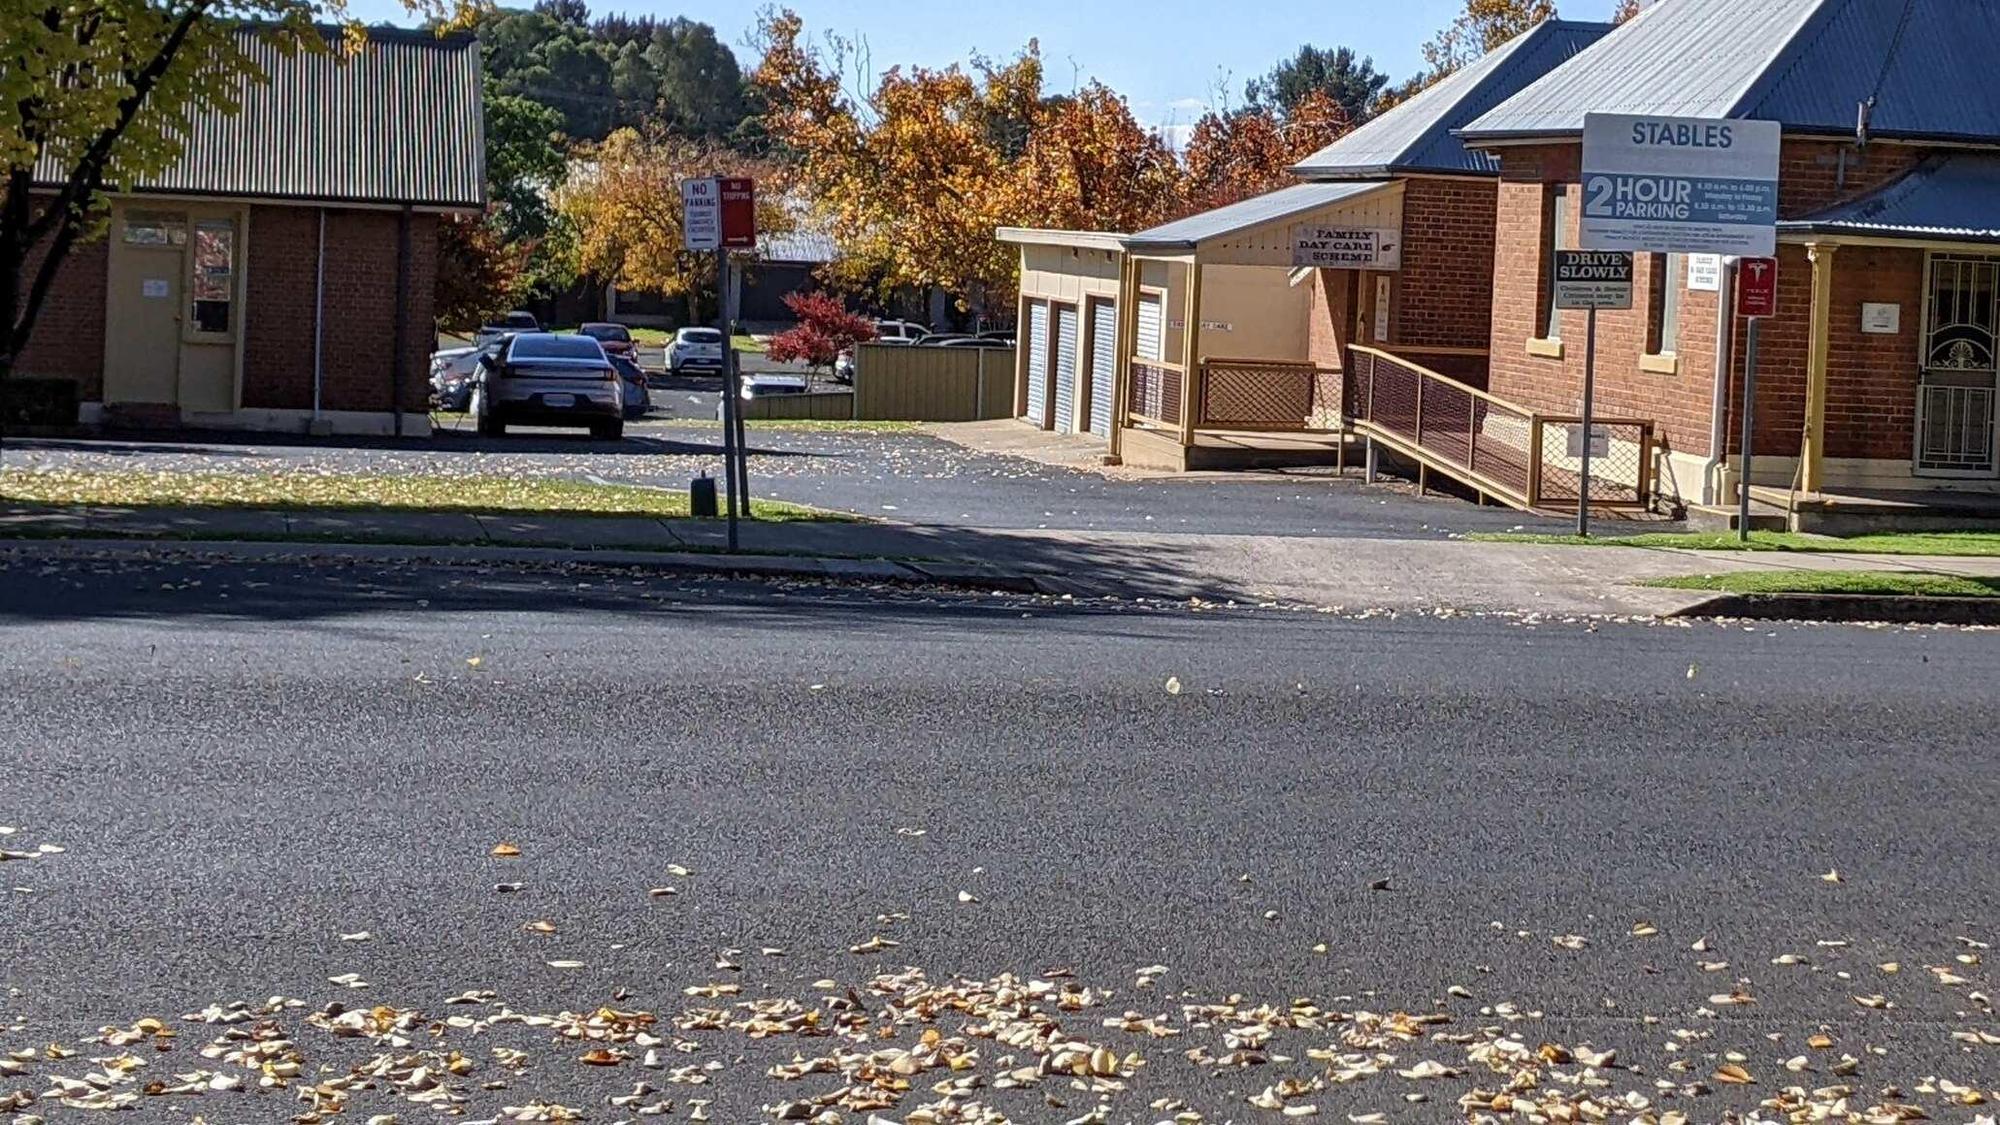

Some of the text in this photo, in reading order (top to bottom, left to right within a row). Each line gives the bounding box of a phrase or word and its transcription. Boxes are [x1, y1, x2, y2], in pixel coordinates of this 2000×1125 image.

[1632, 122, 1733, 149] STABLES
[692, 183, 707, 196] NO
[731, 182, 742, 190] NO
[685, 198, 716, 207] PARKING
[1586, 176, 1691, 216] 2 HOUR
[1615, 202, 1690, 219] PARKING
[1317, 230, 1373, 240] FAMILY
[1299, 240, 1373, 251] DAY CARE
[1313, 252, 1373, 262] SCHEME
[1567, 253, 1622, 266] DRIVE
[1560, 265, 1629, 279] SLOWLY
